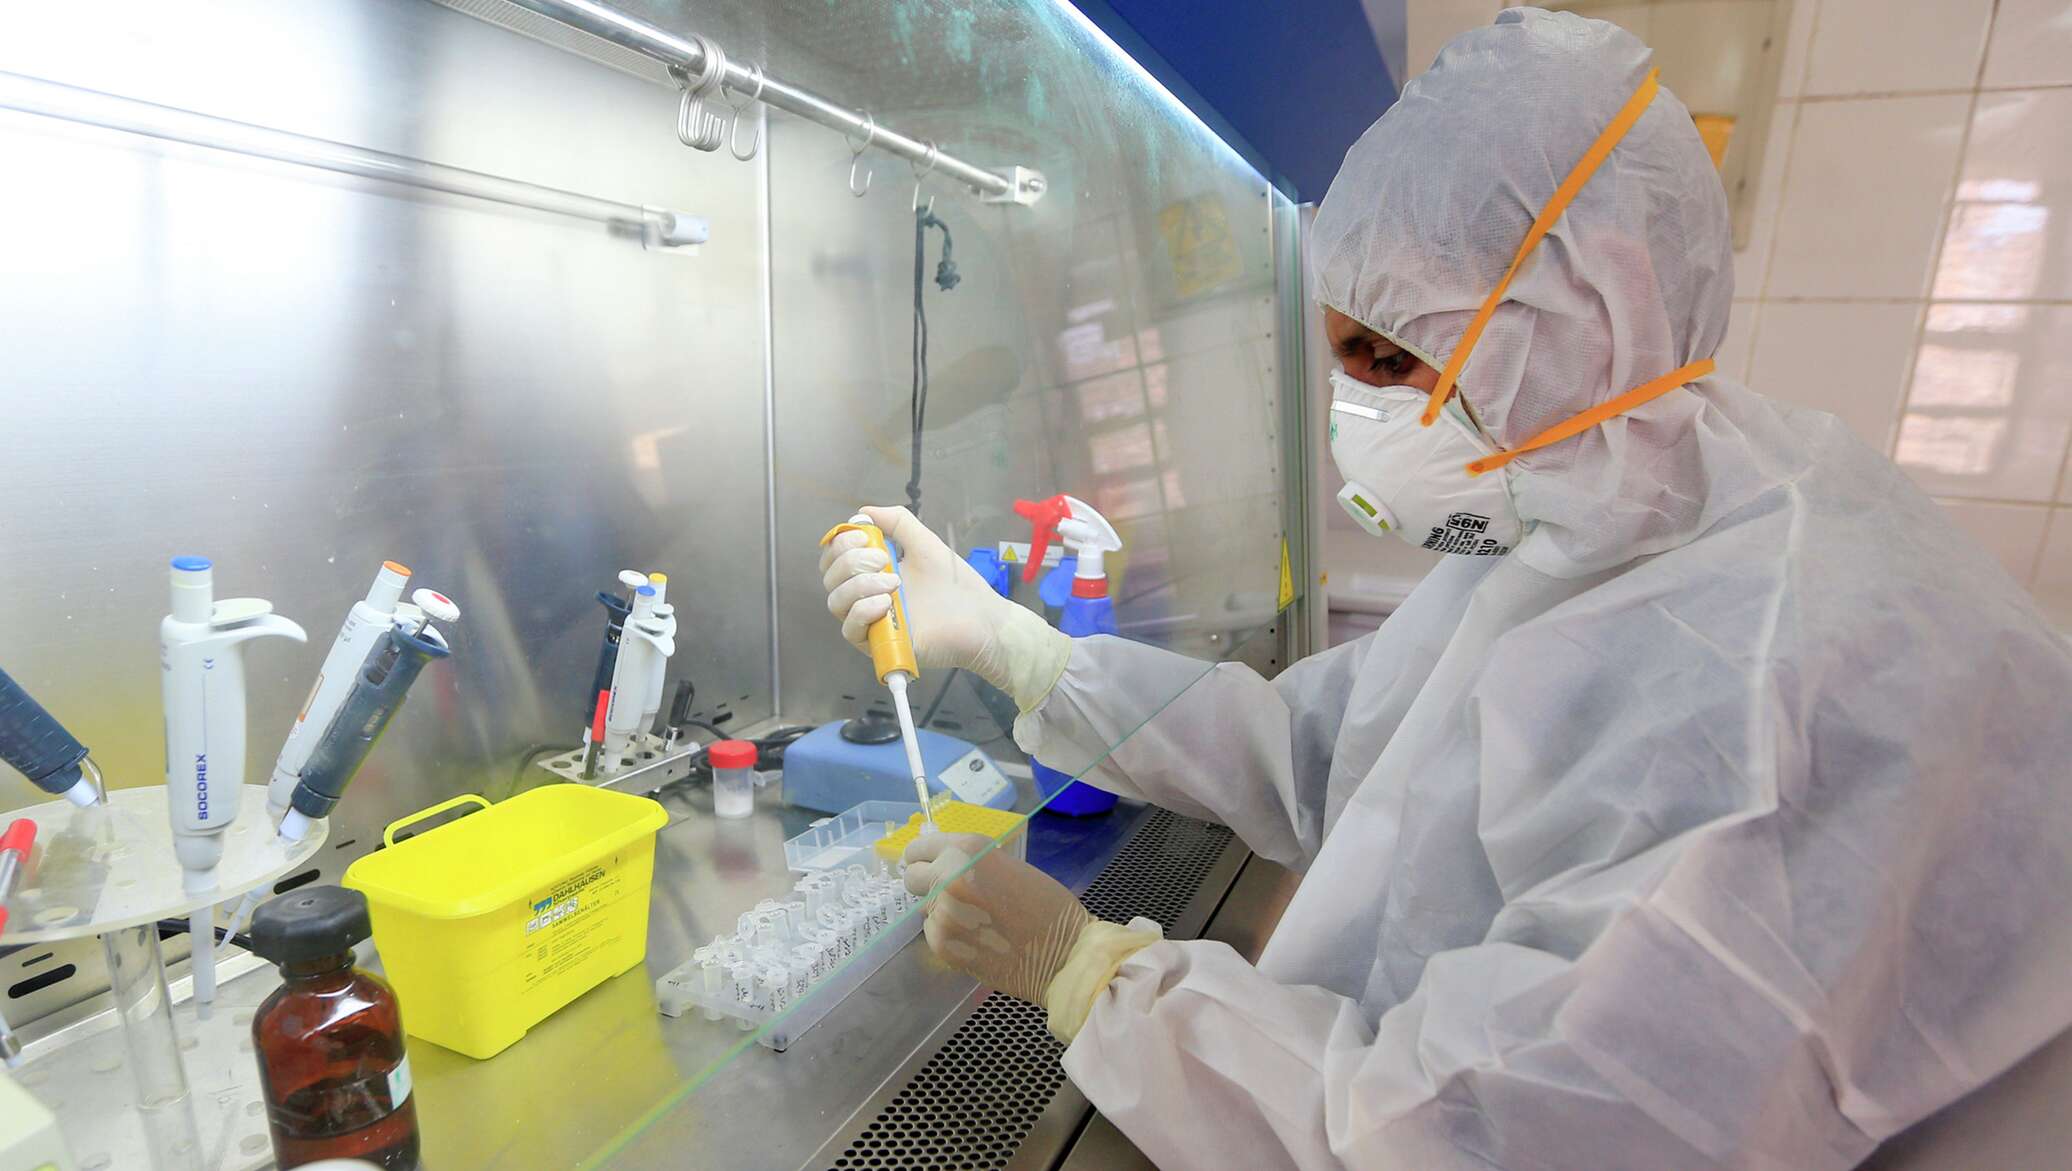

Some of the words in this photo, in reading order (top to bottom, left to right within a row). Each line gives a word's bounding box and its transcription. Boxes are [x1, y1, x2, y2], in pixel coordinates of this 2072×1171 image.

[1449, 514, 1486, 530] N95
[195, 753, 209, 821] SOCOREX
[552, 869, 606, 902] DAHLHAUSEN
